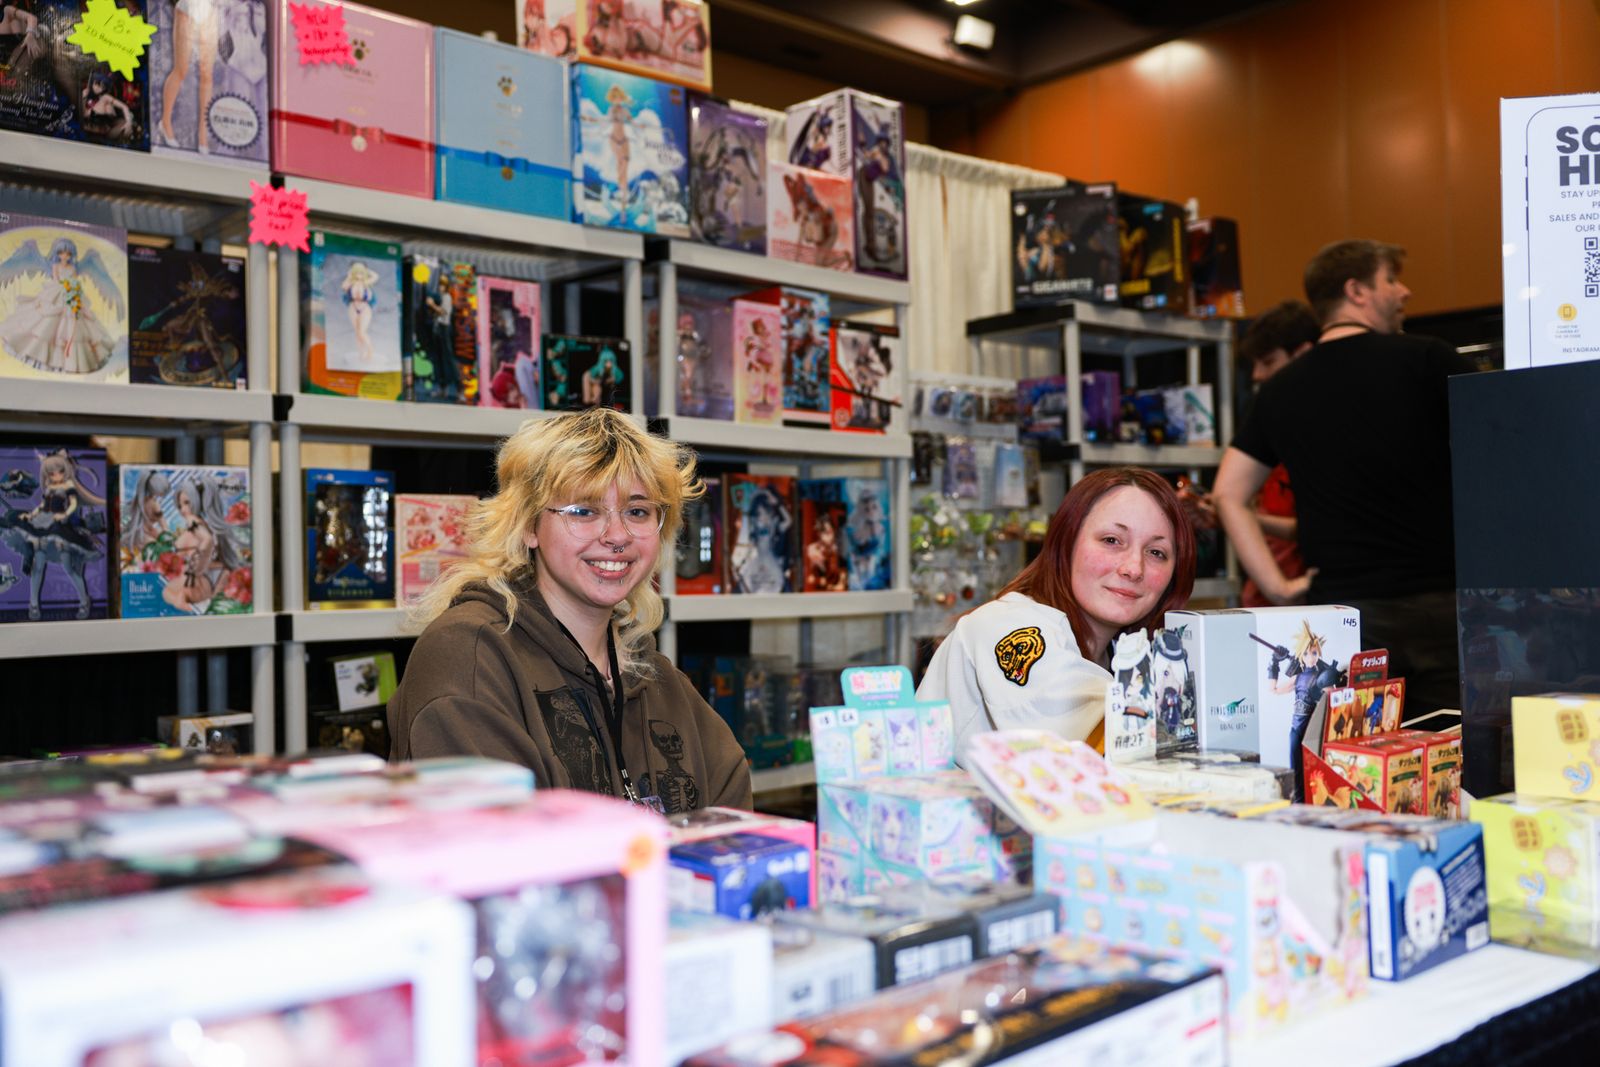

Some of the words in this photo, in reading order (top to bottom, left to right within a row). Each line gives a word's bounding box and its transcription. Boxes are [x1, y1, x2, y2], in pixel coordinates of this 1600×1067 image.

[1560, 190, 1584, 199] STAY
[1549, 213, 1577, 222] SALES
[1579, 212, 1600, 220] AND
[1575, 224, 1596, 232] OUR
[1343, 616, 1358, 628] 145
